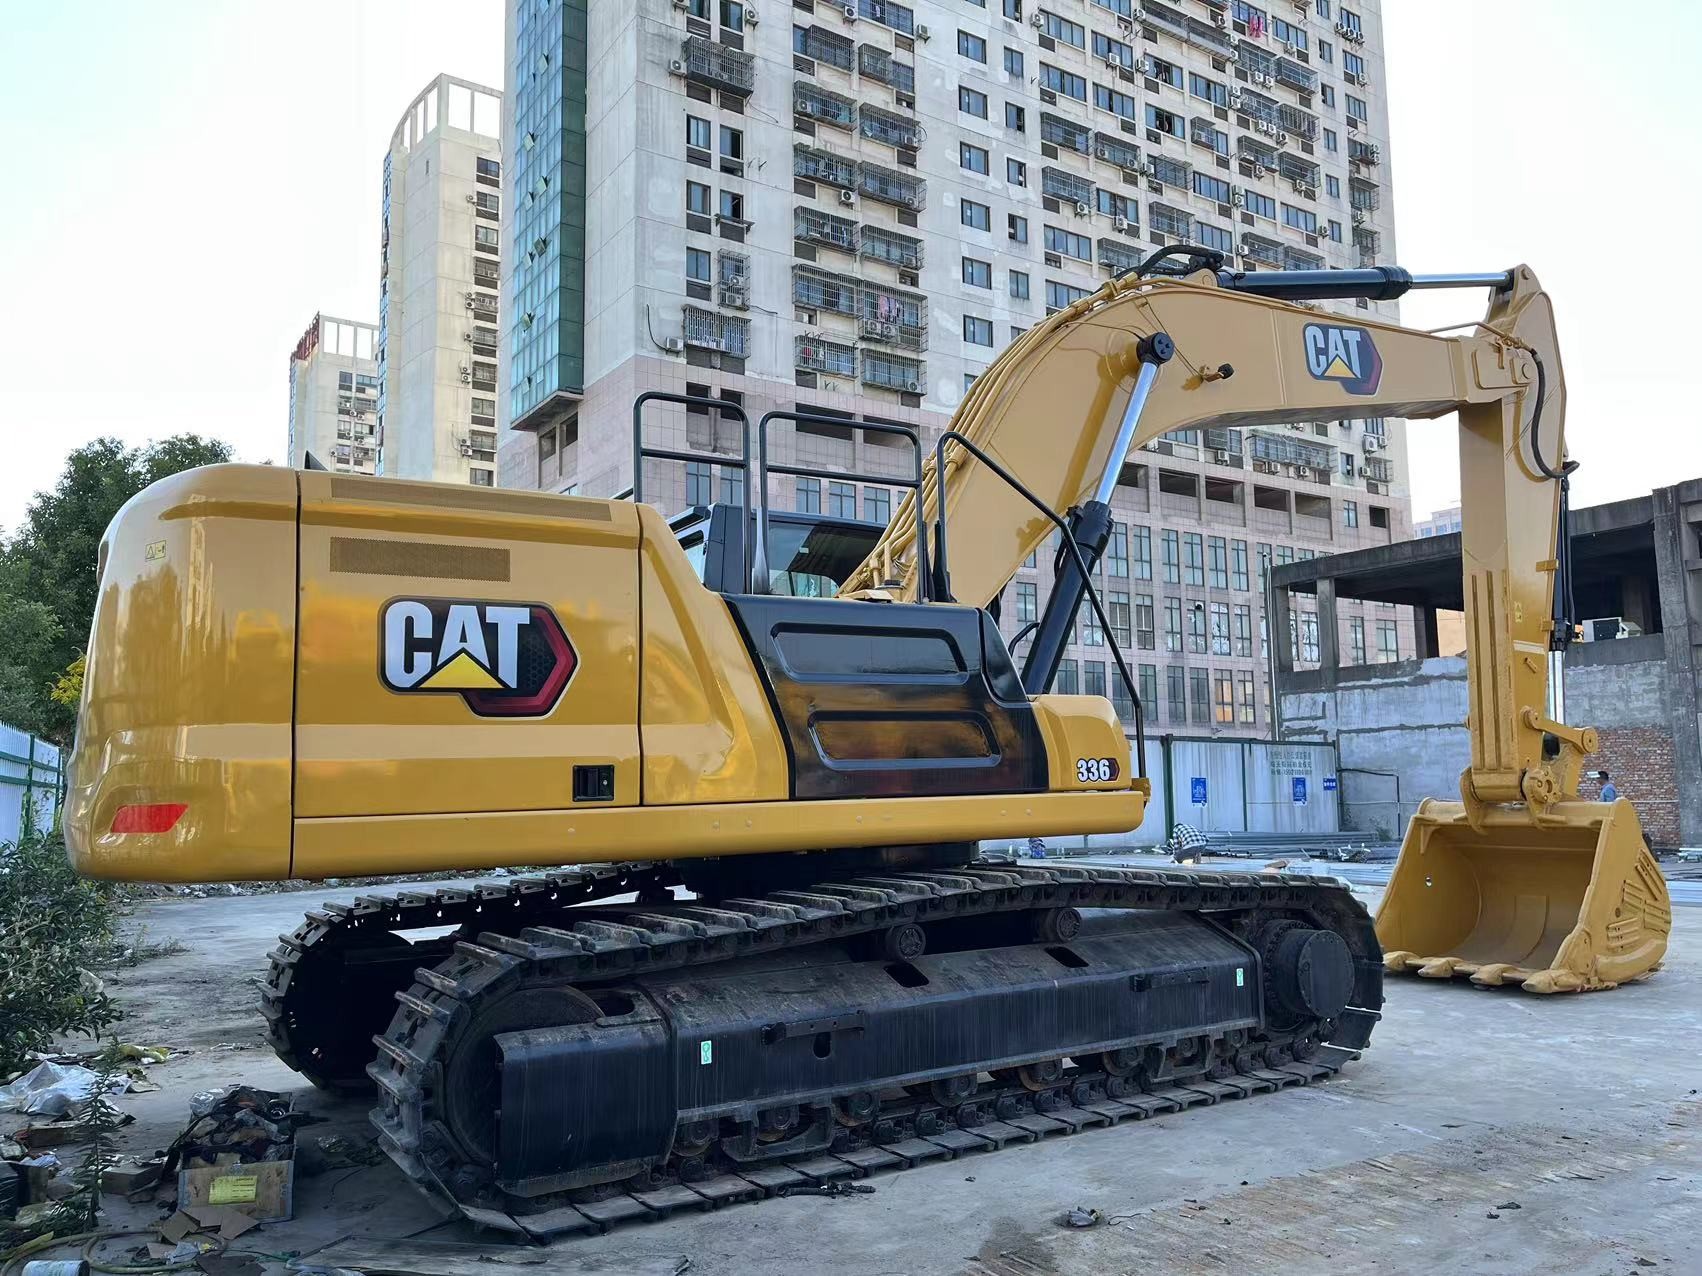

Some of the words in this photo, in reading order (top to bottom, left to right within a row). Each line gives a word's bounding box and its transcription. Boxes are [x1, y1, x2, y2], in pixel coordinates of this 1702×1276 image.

[1305, 325, 1361, 378] CAT
[385, 601, 530, 689] CAT
[1077, 758, 1110, 782] 336
